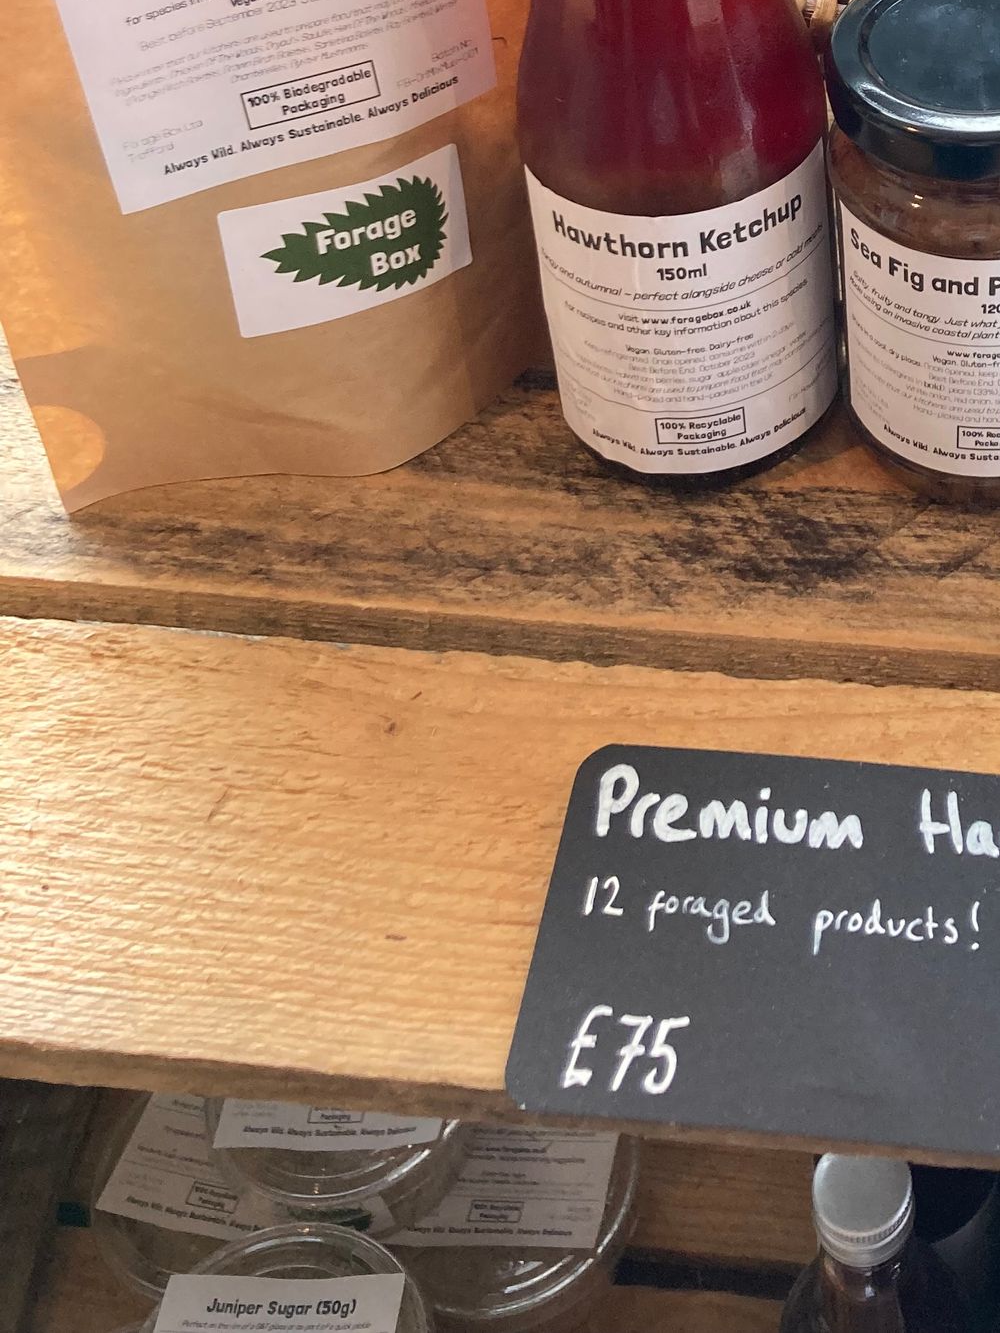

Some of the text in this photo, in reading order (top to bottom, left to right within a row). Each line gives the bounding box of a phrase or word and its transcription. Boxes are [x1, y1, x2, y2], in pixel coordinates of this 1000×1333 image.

[247, 68, 373, 110] 100% Biodegradable
[281, 92, 346, 117] Packaging
[164, 151, 209, 176] Always
[241, 132, 284, 153] Always
[367, 98, 409, 121] Always
[411, 76, 460, 105] Delicious
[315, 208, 417, 255] Forage
[552, 193, 802, 258] Hawthorn Ketchup
[369, 243, 422, 278] Box
[656, 263, 708, 282] 150ml
[850, 227, 883, 269] Sea
[888, 257, 925, 293] Fig
[931, 276, 979, 296] and
[595, 762, 864, 851] Premium
[582, 875, 982, 956] 12 foraged products!
[561, 1004, 691, 1095] £75
[206, 1297, 357, 1320] Juniper Sugar (50g)
